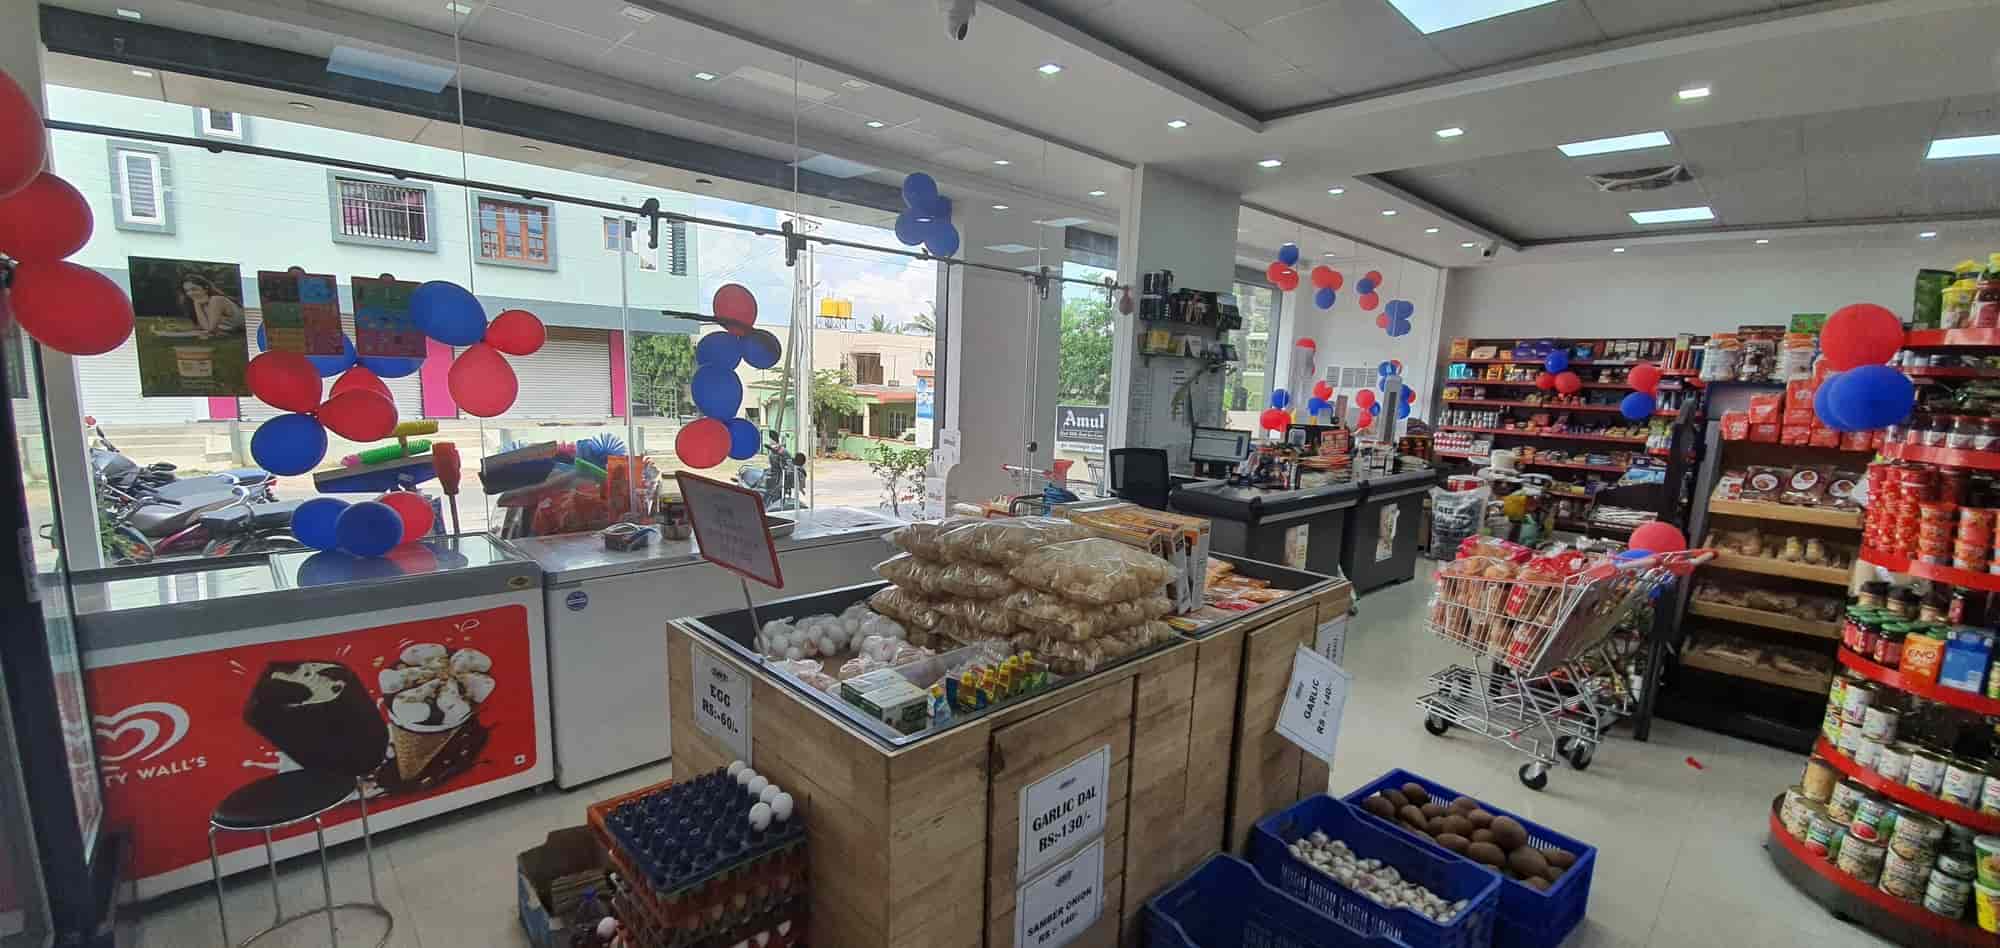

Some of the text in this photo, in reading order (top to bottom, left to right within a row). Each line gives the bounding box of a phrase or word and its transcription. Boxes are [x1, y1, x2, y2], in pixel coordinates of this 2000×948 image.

[1063, 409, 1105, 429] Amul
[709, 683, 731, 708] EGG
[1303, 678, 1320, 720] GARLIC
[136, 754, 208, 780] WALL'S
[1032, 785, 1097, 832] GARLIC DAL
[1066, 885, 1093, 911] ONION
